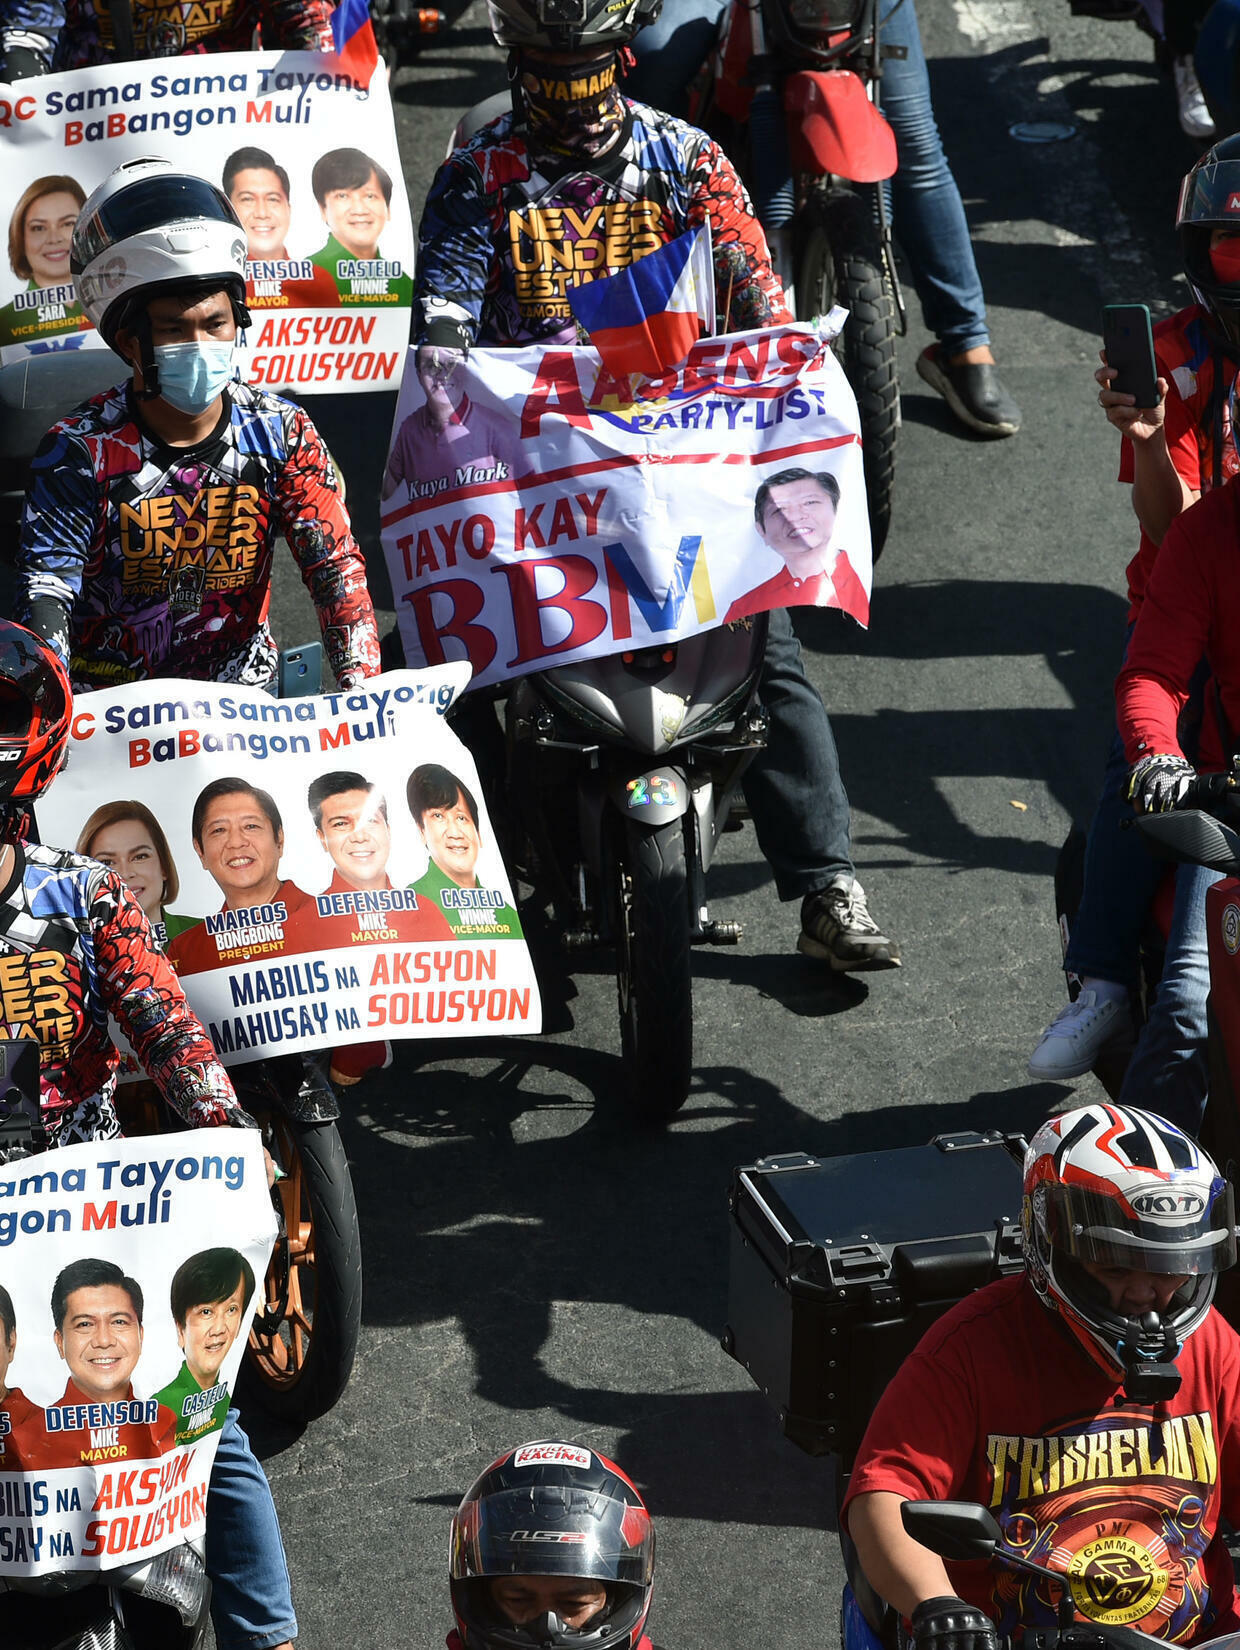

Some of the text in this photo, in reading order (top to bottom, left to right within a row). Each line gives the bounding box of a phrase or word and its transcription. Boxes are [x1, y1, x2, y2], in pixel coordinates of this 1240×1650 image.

[45, 83, 142, 116] Sama
[150, 74, 248, 100] Sama
[64, 98, 312, 147] BaBangon Muli
[509, 200, 664, 242] NEVER
[511, 232, 663, 272] UNDER
[245, 260, 314, 281] FENSOR
[336, 260, 403, 279] CASTELO
[12, 285, 75, 312] DUTERT
[246, 296, 289, 307] MAYOR
[253, 280, 282, 297] MIKE
[338, 293, 400, 303] VICE-MAYOR
[350, 278, 390, 295] WINNIE
[11, 315, 89, 337] VICE-PRESIDEN
[37, 304, 67, 322] SARA
[256, 316, 377, 348] AKSYON
[248, 352, 400, 385] SOLUSYON
[631, 388, 828, 430] PARTY-LIST
[408, 461, 509, 500] Kuya Mark
[119, 484, 261, 531] NEVER
[120, 515, 259, 560] UNDER
[396, 488, 608, 582] TAYO KAY
[169, 589, 202, 603] RIDERS
[204, 573, 256, 591] RIDERS
[401, 535, 717, 680] BBM
[70, 712, 96, 741] C
[104, 697, 212, 734] Sama
[218, 697, 316, 723] Sama
[129, 709, 396, 769] BaBangon Muli
[626, 775, 678, 809] 23
[316, 889, 420, 919] DEFENSOR
[439, 888, 506, 910] CASTELO
[205, 900, 289, 936] MARCOS
[357, 912, 388, 931] MIKE
[449, 924, 512, 935] VICE-MAYOR
[458, 908, 499, 926] WINNIE
[215, 922, 285, 951] BONGBONG
[218, 941, 286, 961] PRESIDENT
[351, 929, 399, 943] MAYOR
[228, 949, 498, 1008] MABILIS NA AKSYON
[208, 987, 531, 1056] MAHUSAY NA SOLUSYON
[97, 1154, 246, 1197] Tayong
[82, 1189, 173, 1231] Muli
[1143, 1196, 1200, 1213] KYT
[181, 1380, 229, 1417] CASTELO
[45, 1399, 159, 1432] DEFENSOR
[80, 1445, 128, 1462] MAYOR
[89, 1426, 120, 1449] MIKE
[517, 1451, 588, 1464] RACING
[986, 1411, 1219, 1509] TRISKELION
[56, 1487, 82, 1514] NA
[91, 1448, 198, 1513] AKSYON
[49, 1531, 75, 1559] NA
[80, 1482, 207, 1558] SOLUSYON
[510, 1530, 589, 1544] LS2
[1083, 1540, 1137, 1558] GAMMA
[1139, 1552, 1155, 1572] PH
[1123, 1589, 1161, 1621] FRATERNITAS
